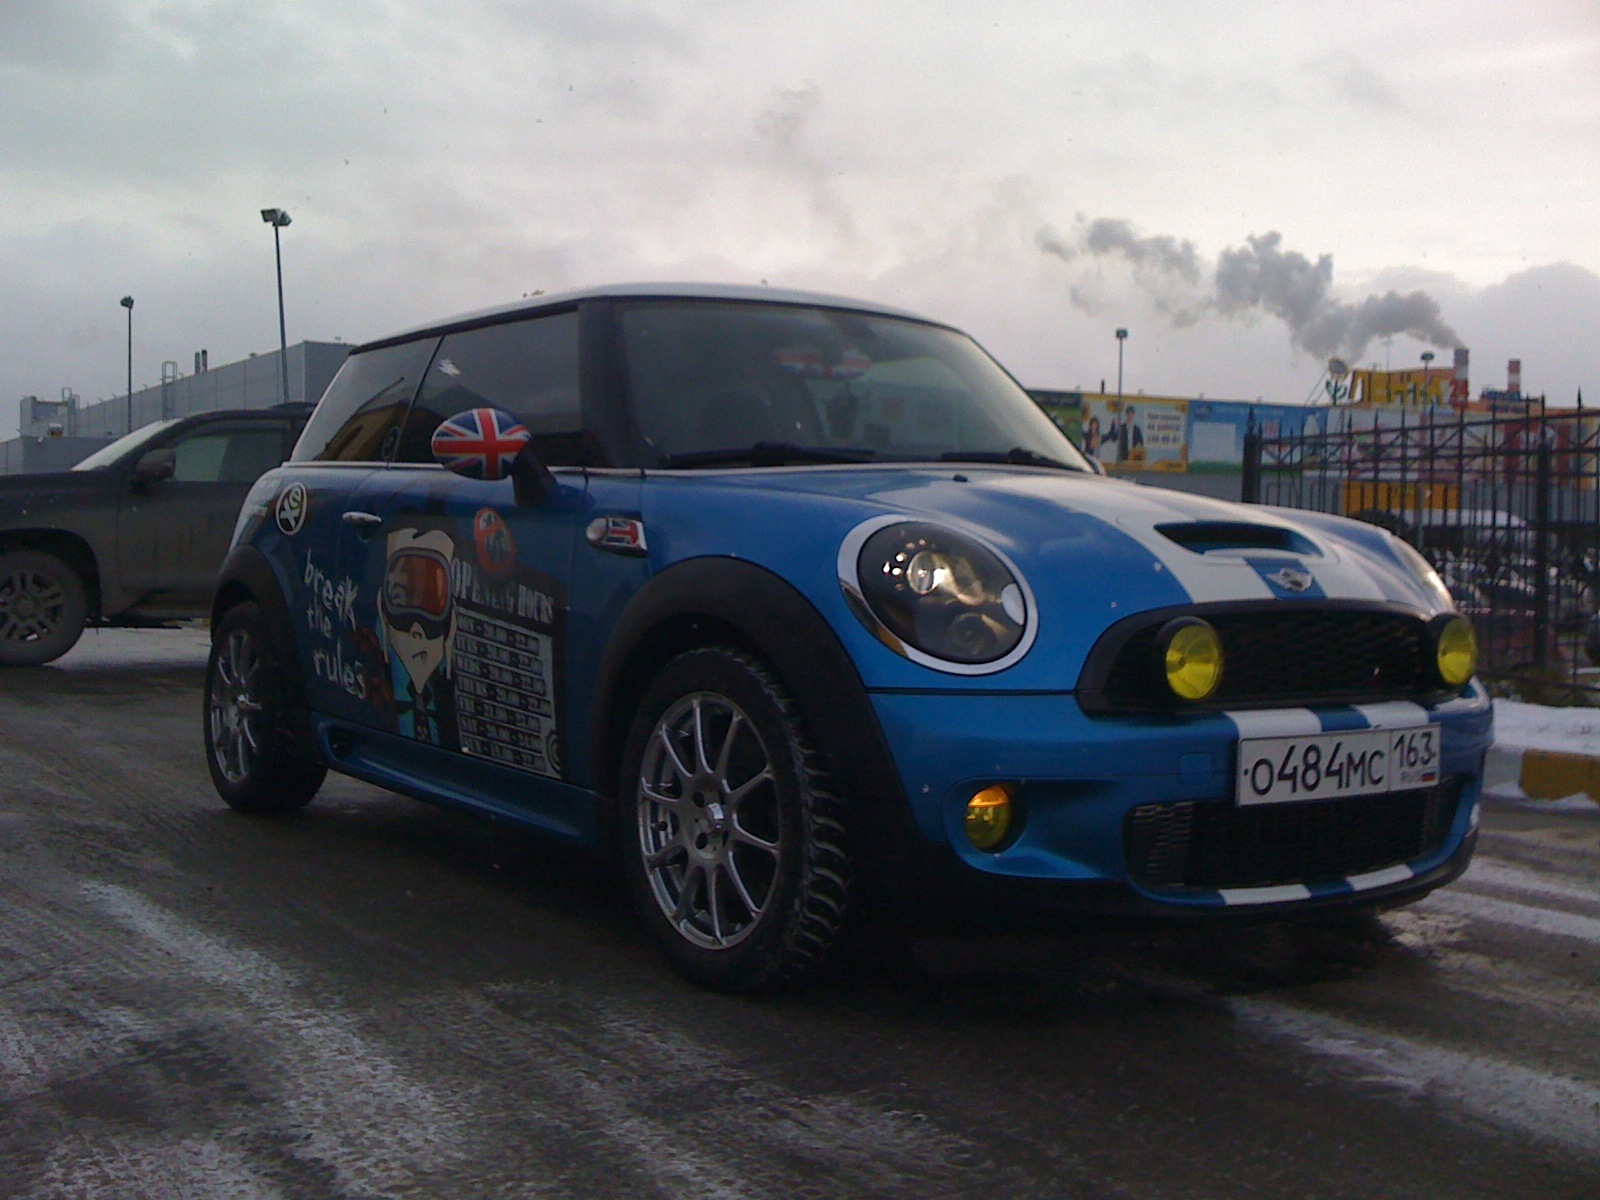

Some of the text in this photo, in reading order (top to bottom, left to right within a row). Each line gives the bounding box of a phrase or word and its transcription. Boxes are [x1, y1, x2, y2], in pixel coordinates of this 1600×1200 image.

[304, 549, 358, 631] break
[306, 598, 332, 639] the
[313, 635, 367, 700] rules
[1393, 731, 1437, 769] 163
